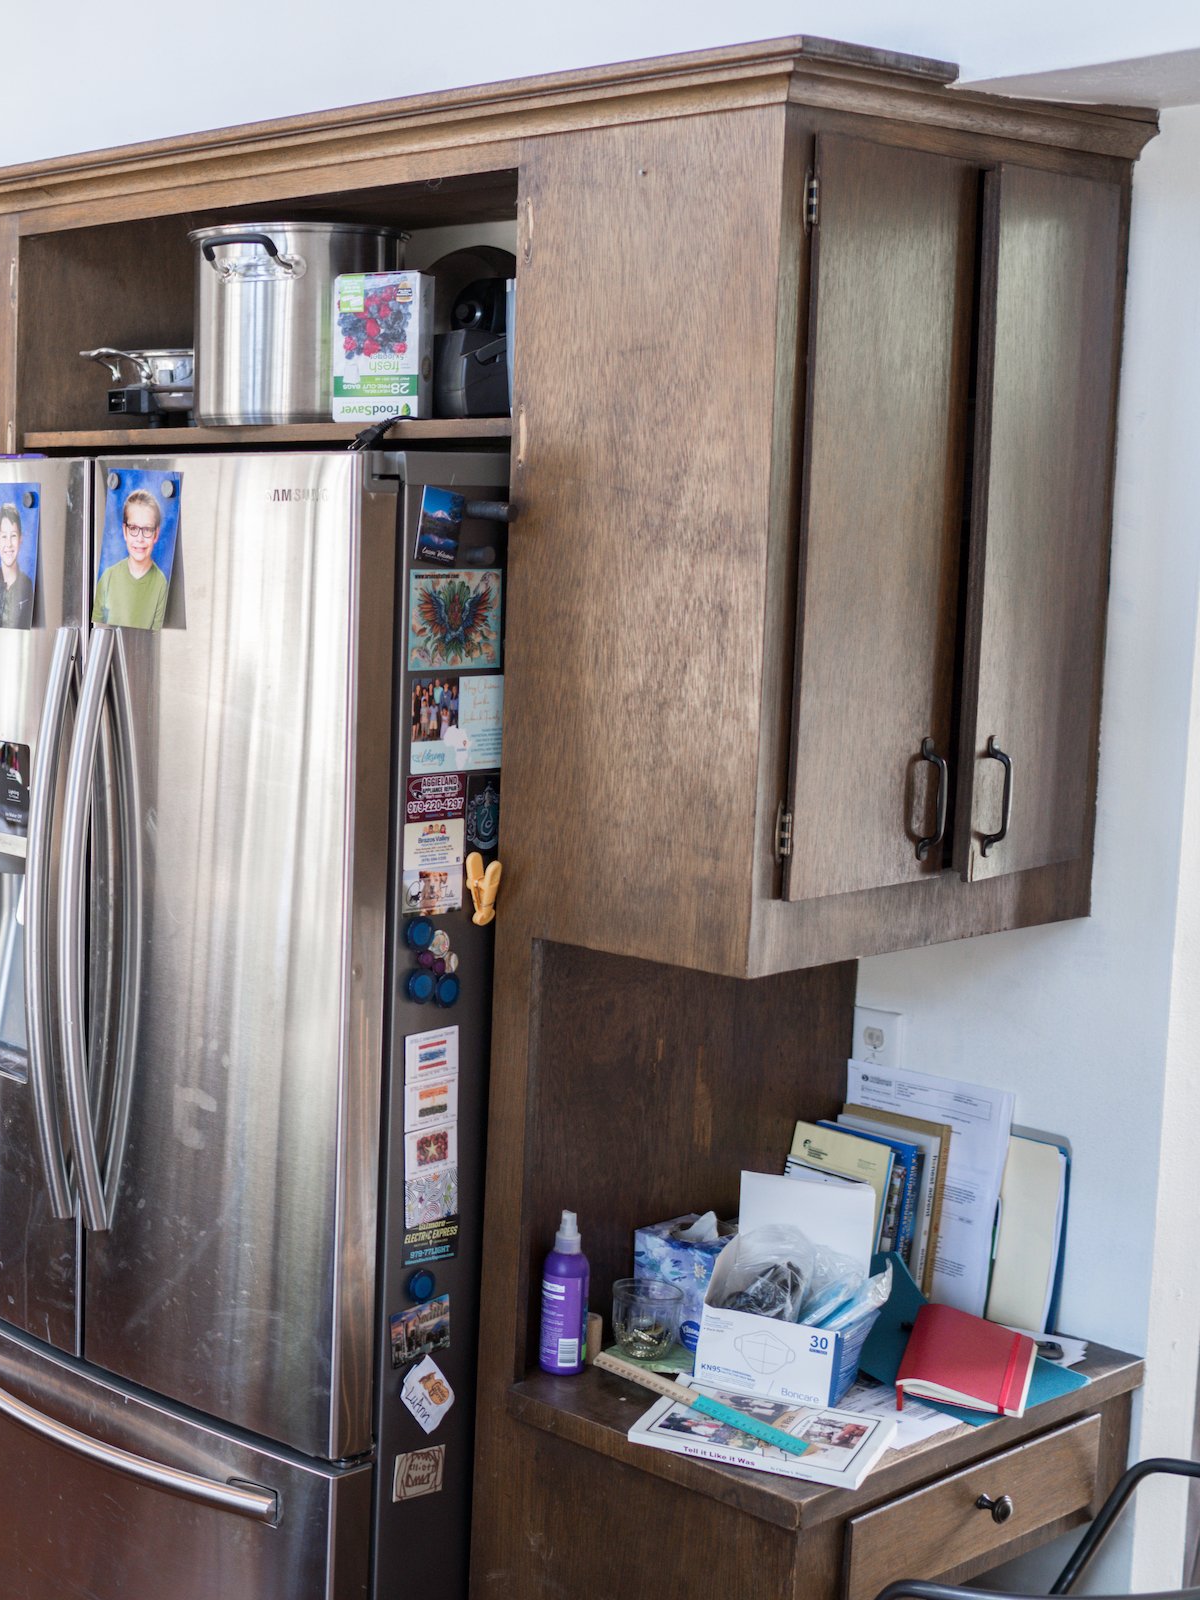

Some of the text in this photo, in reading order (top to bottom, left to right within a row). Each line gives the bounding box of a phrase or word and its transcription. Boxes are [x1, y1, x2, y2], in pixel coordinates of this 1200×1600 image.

[369, 361, 399, 373] fresh
[391, 383, 410, 394] 28
[341, 405, 399, 416] FoodSaver
[264, 487, 329, 503] SAMSUNG
[422, 775, 458, 787] AGGIELAND
[407, 798, 464, 814] 979-220-4297
[809, 1335, 829, 1350] 30
[700, 1363, 721, 1373] KN95
[781, 1387, 820, 1404] Boncare
[683, 1446, 755, 1467] Tell it Like it Was
